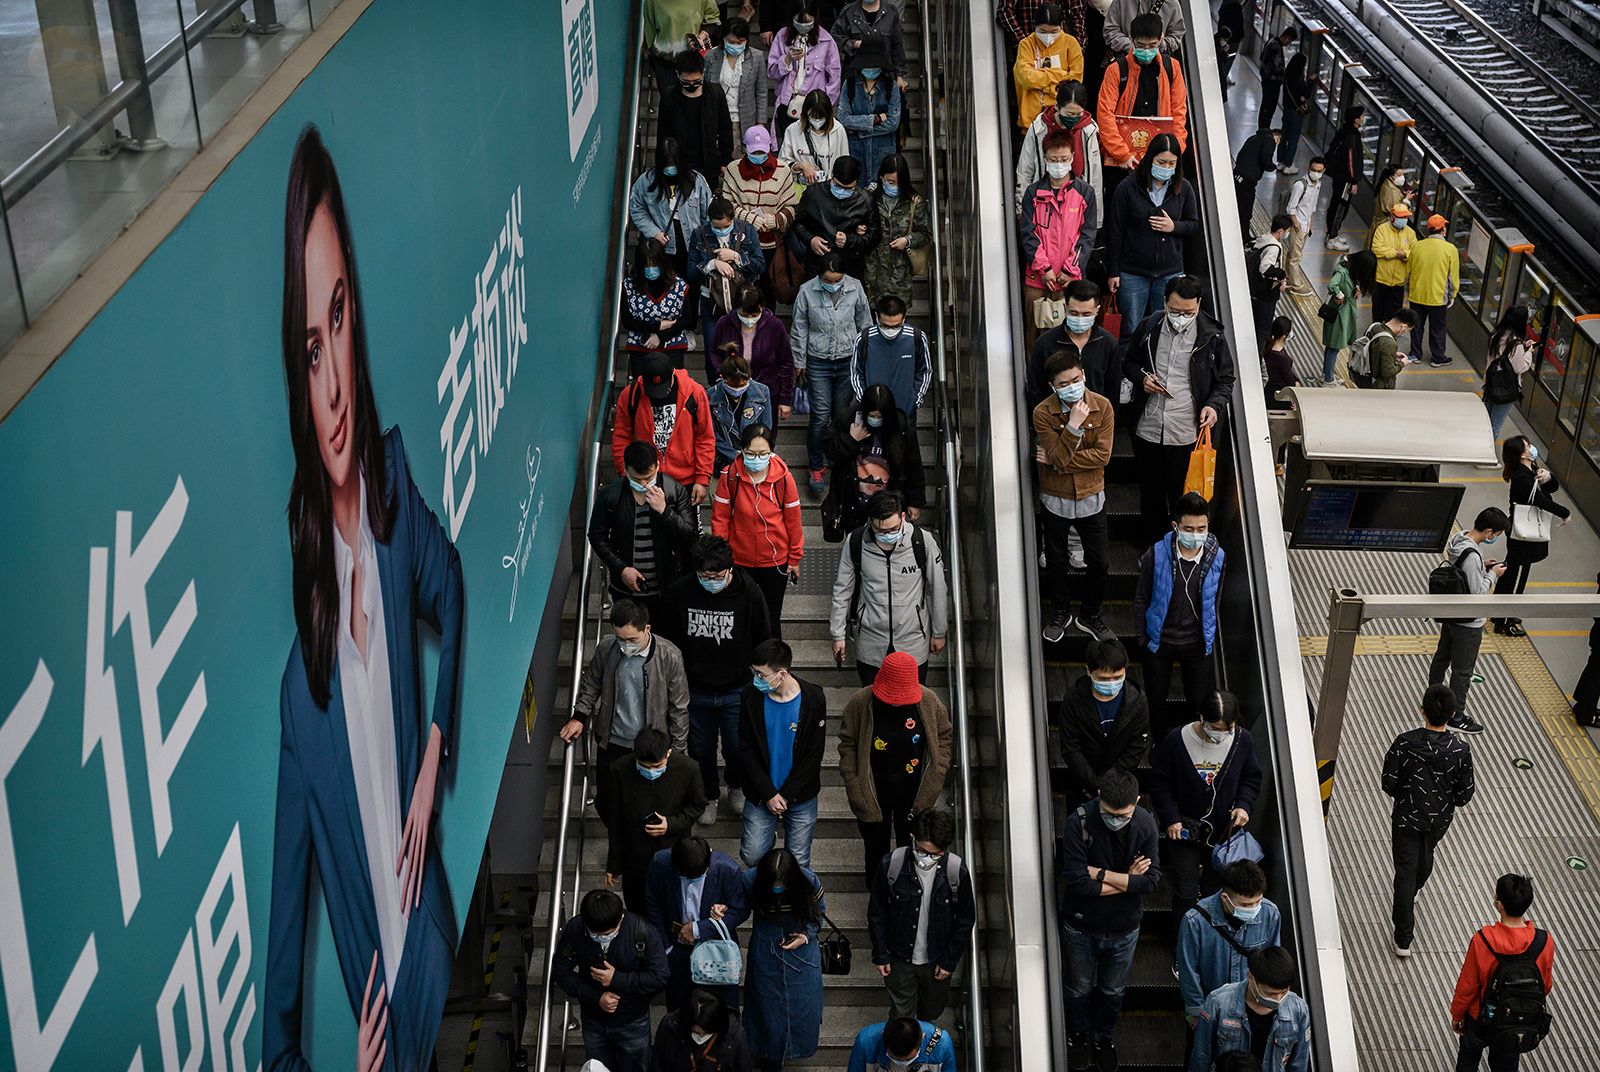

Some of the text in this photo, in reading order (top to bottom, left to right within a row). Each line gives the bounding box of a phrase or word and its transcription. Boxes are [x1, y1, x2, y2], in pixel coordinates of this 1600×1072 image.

[437, 185, 529, 543] 老板谈
[688, 612, 734, 628] LINKIN
[687, 622, 733, 645] PARK
